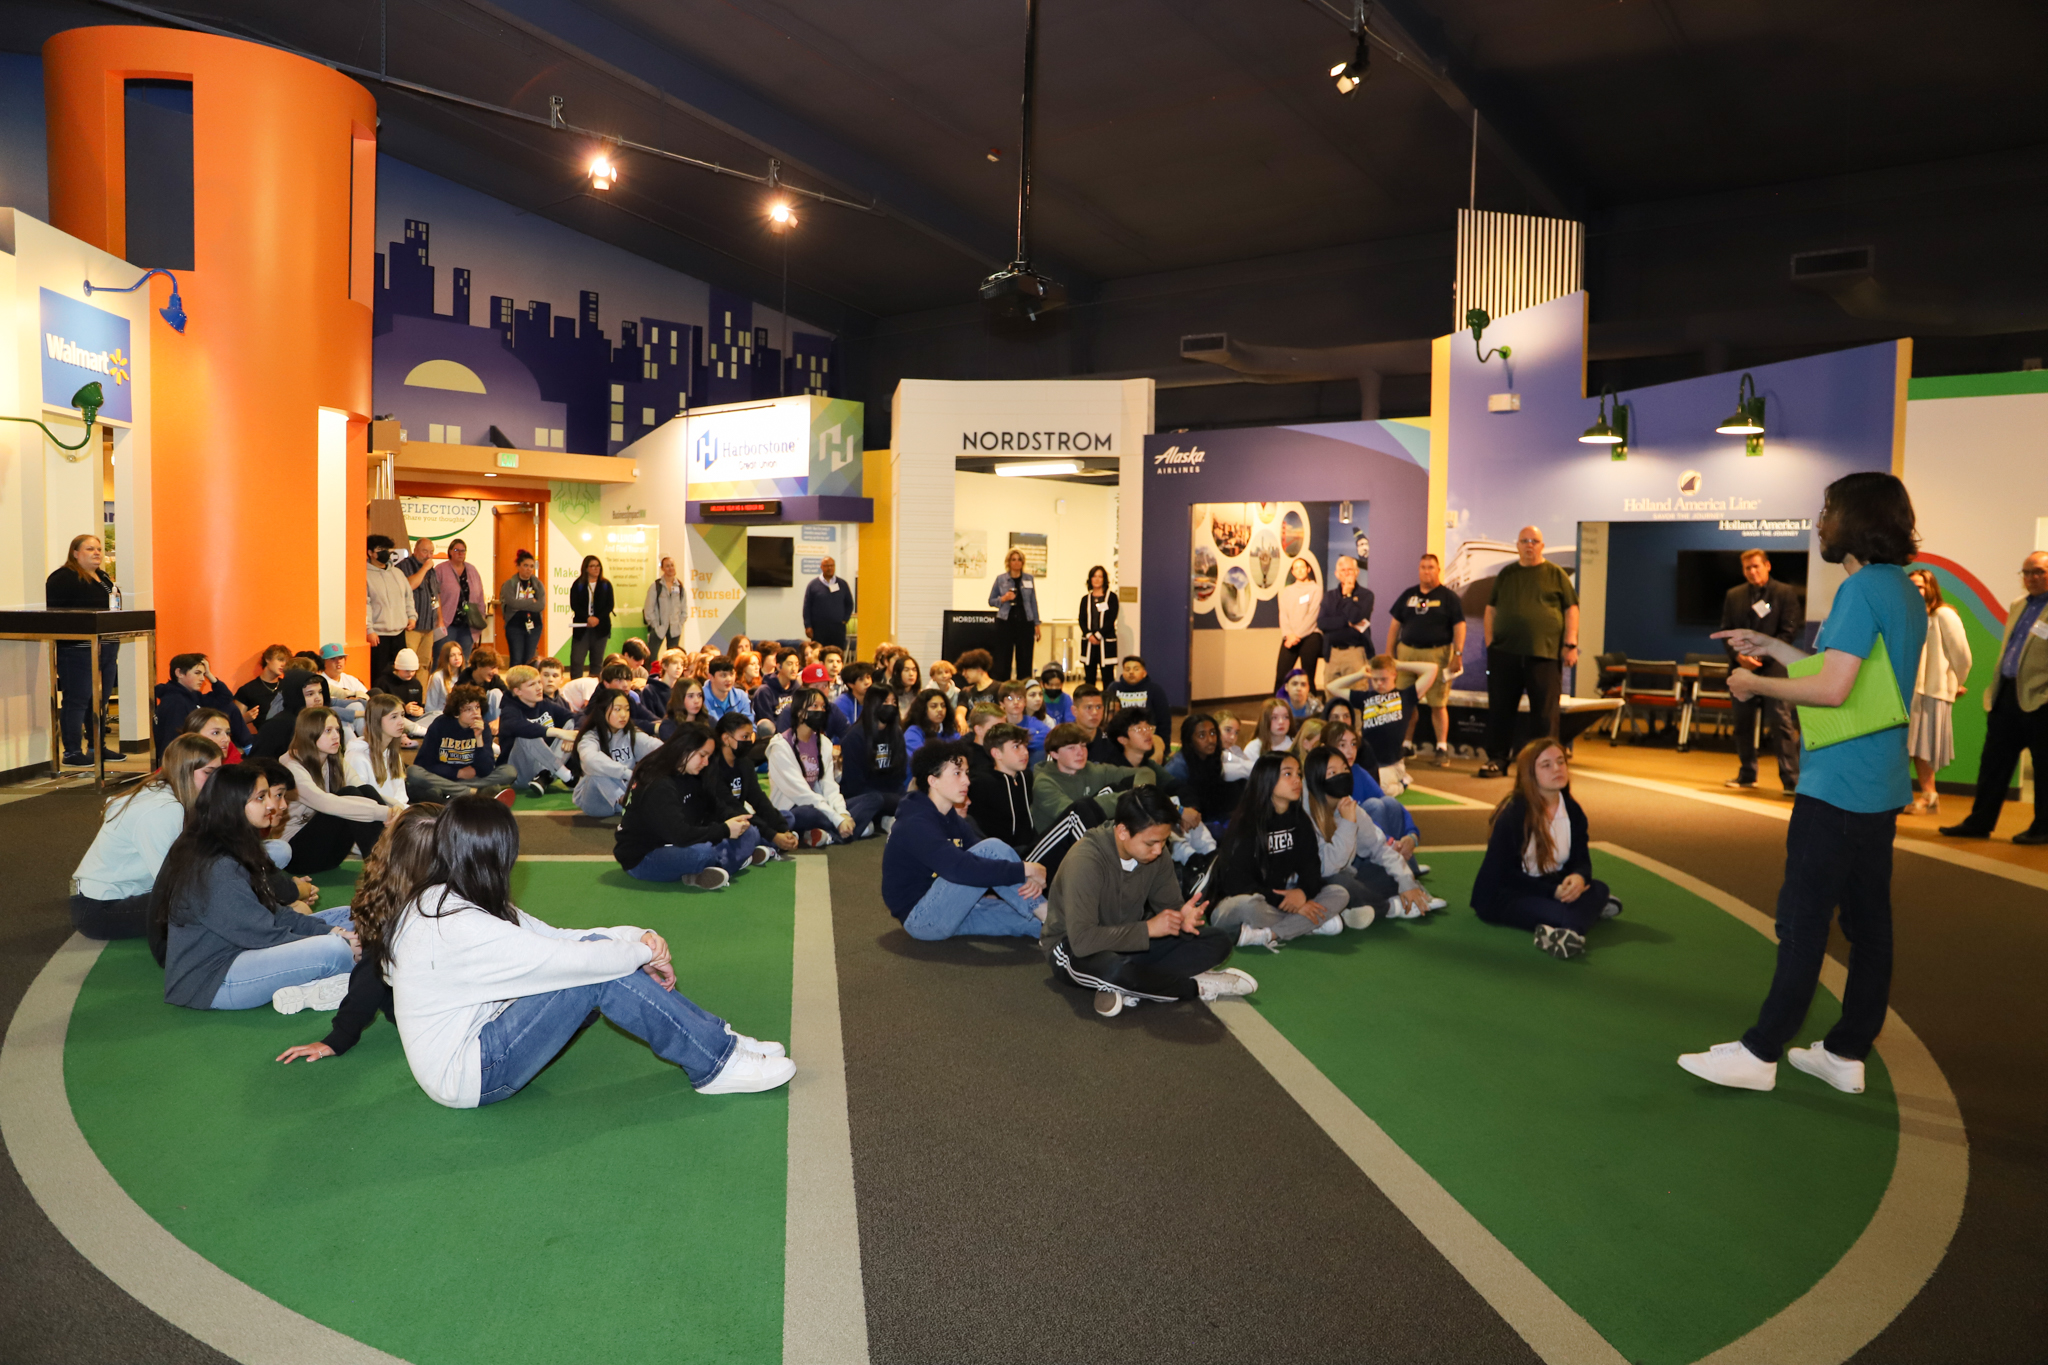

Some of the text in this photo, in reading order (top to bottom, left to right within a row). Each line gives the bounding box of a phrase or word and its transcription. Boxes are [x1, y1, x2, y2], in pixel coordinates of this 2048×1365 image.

[46, 333, 109, 375] Walmart
[963, 431, 1112, 450] NORDSTROM
[722, 440, 796, 458] Harborstone
[1154, 446, 1205, 465] Alaska
[501, 453, 516, 467] EXIT
[1157, 466, 1200, 475] AIRLINES
[401, 503, 477, 516] EFLECTIONS
[1623, 496, 1758, 512] Holland America Line
[1718, 519, 1758, 531] Holland
[1758, 518, 1800, 531] America
[553, 567, 579, 578] Make
[690, 569, 713, 584] Pay
[553, 584, 570, 595] You
[691, 588, 741, 600] Yourself
[690, 606, 719, 618] First
